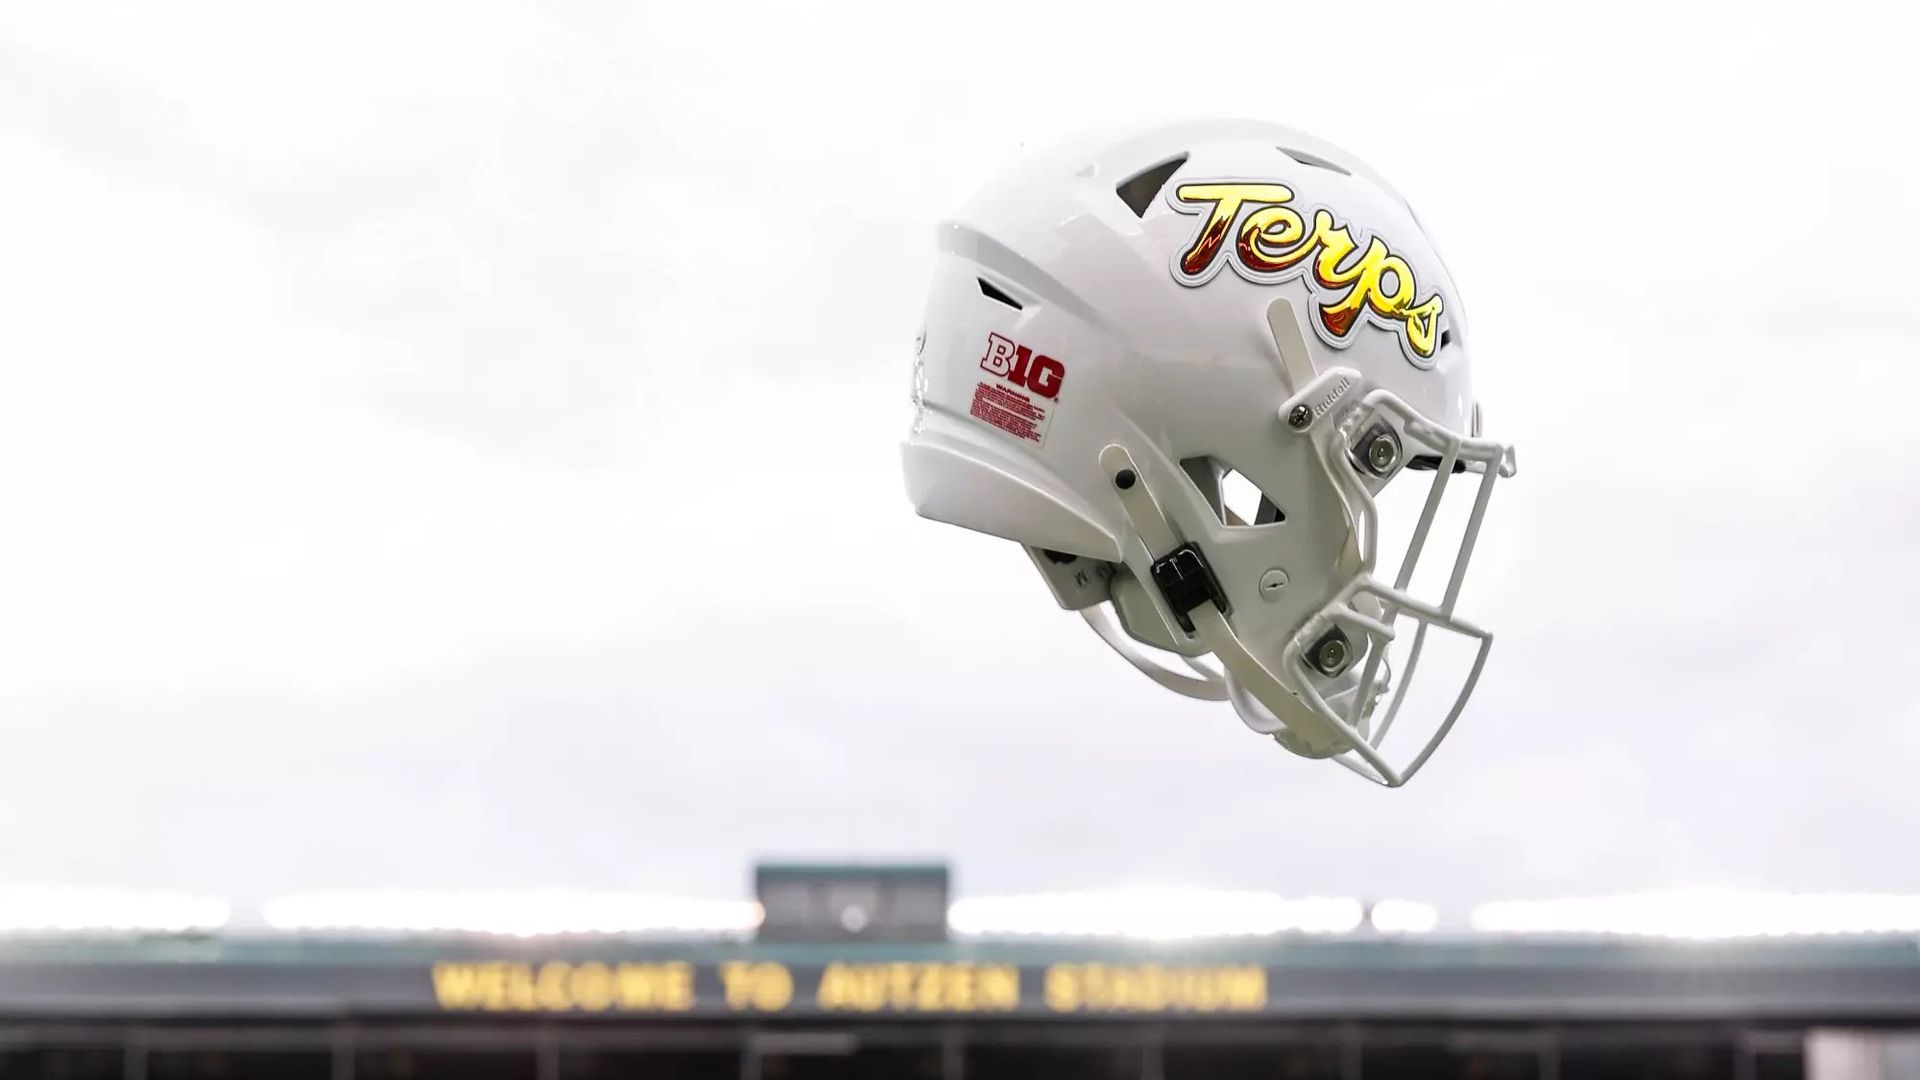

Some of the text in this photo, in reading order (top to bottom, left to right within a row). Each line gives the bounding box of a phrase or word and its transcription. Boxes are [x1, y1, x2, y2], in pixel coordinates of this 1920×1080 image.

[1176, 183, 1444, 358] Terps
[433, 962, 1265, 1010] WELCOME TO AUTZEN STADIUM
